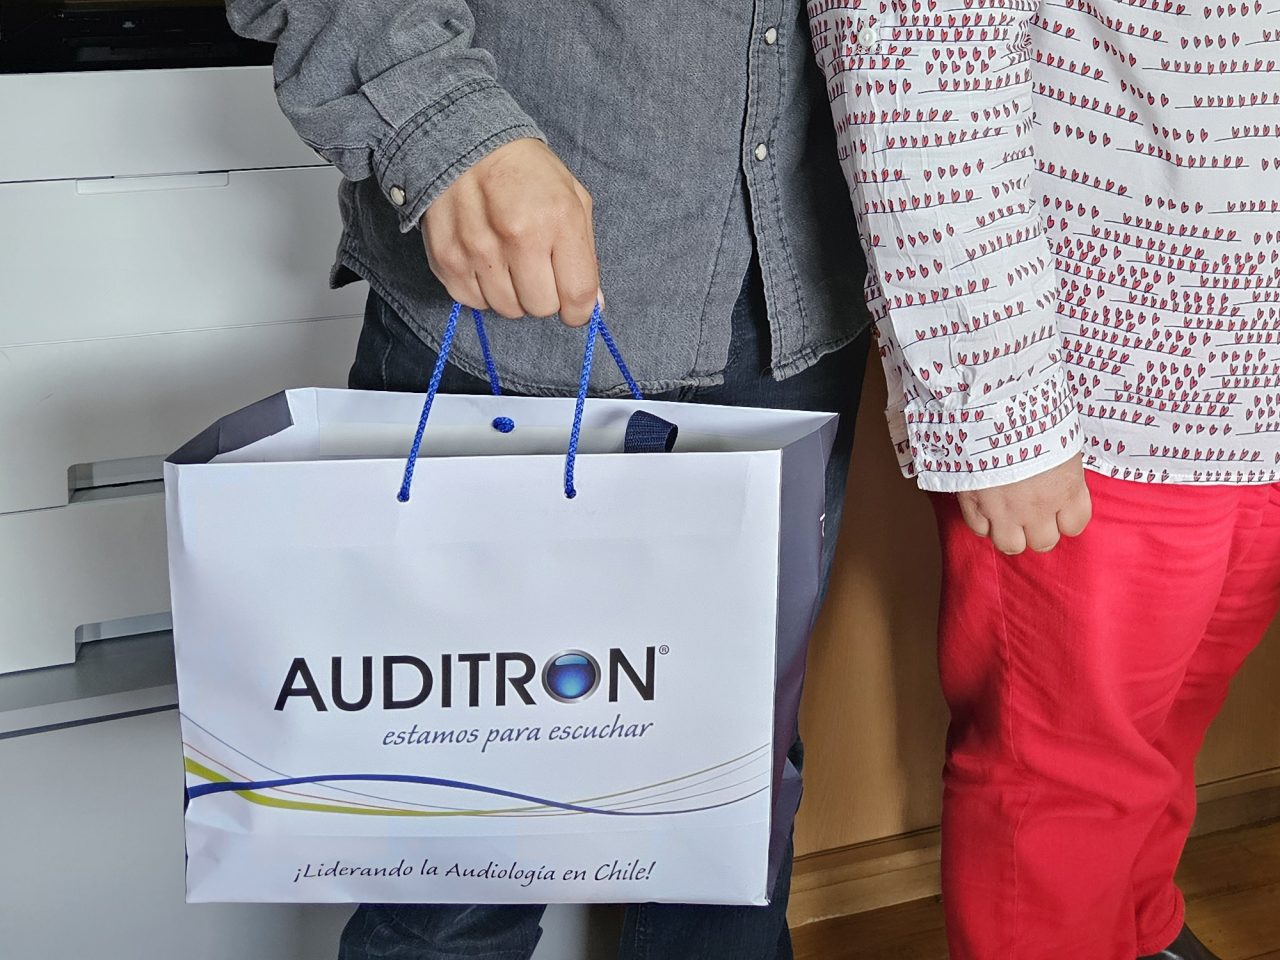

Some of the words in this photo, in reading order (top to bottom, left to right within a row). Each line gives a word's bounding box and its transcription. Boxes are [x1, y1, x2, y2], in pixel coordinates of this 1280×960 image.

[382, 724, 479, 746] estamos
[481, 728, 541, 753] para
[548, 714, 654, 742] escuchar
[293, 860, 414, 883] ¡Liderando
[419, 859, 438, 877] la
[444, 862, 556, 887] Audiología
[562, 870, 586, 882] en
[594, 860, 657, 883] Chile!
